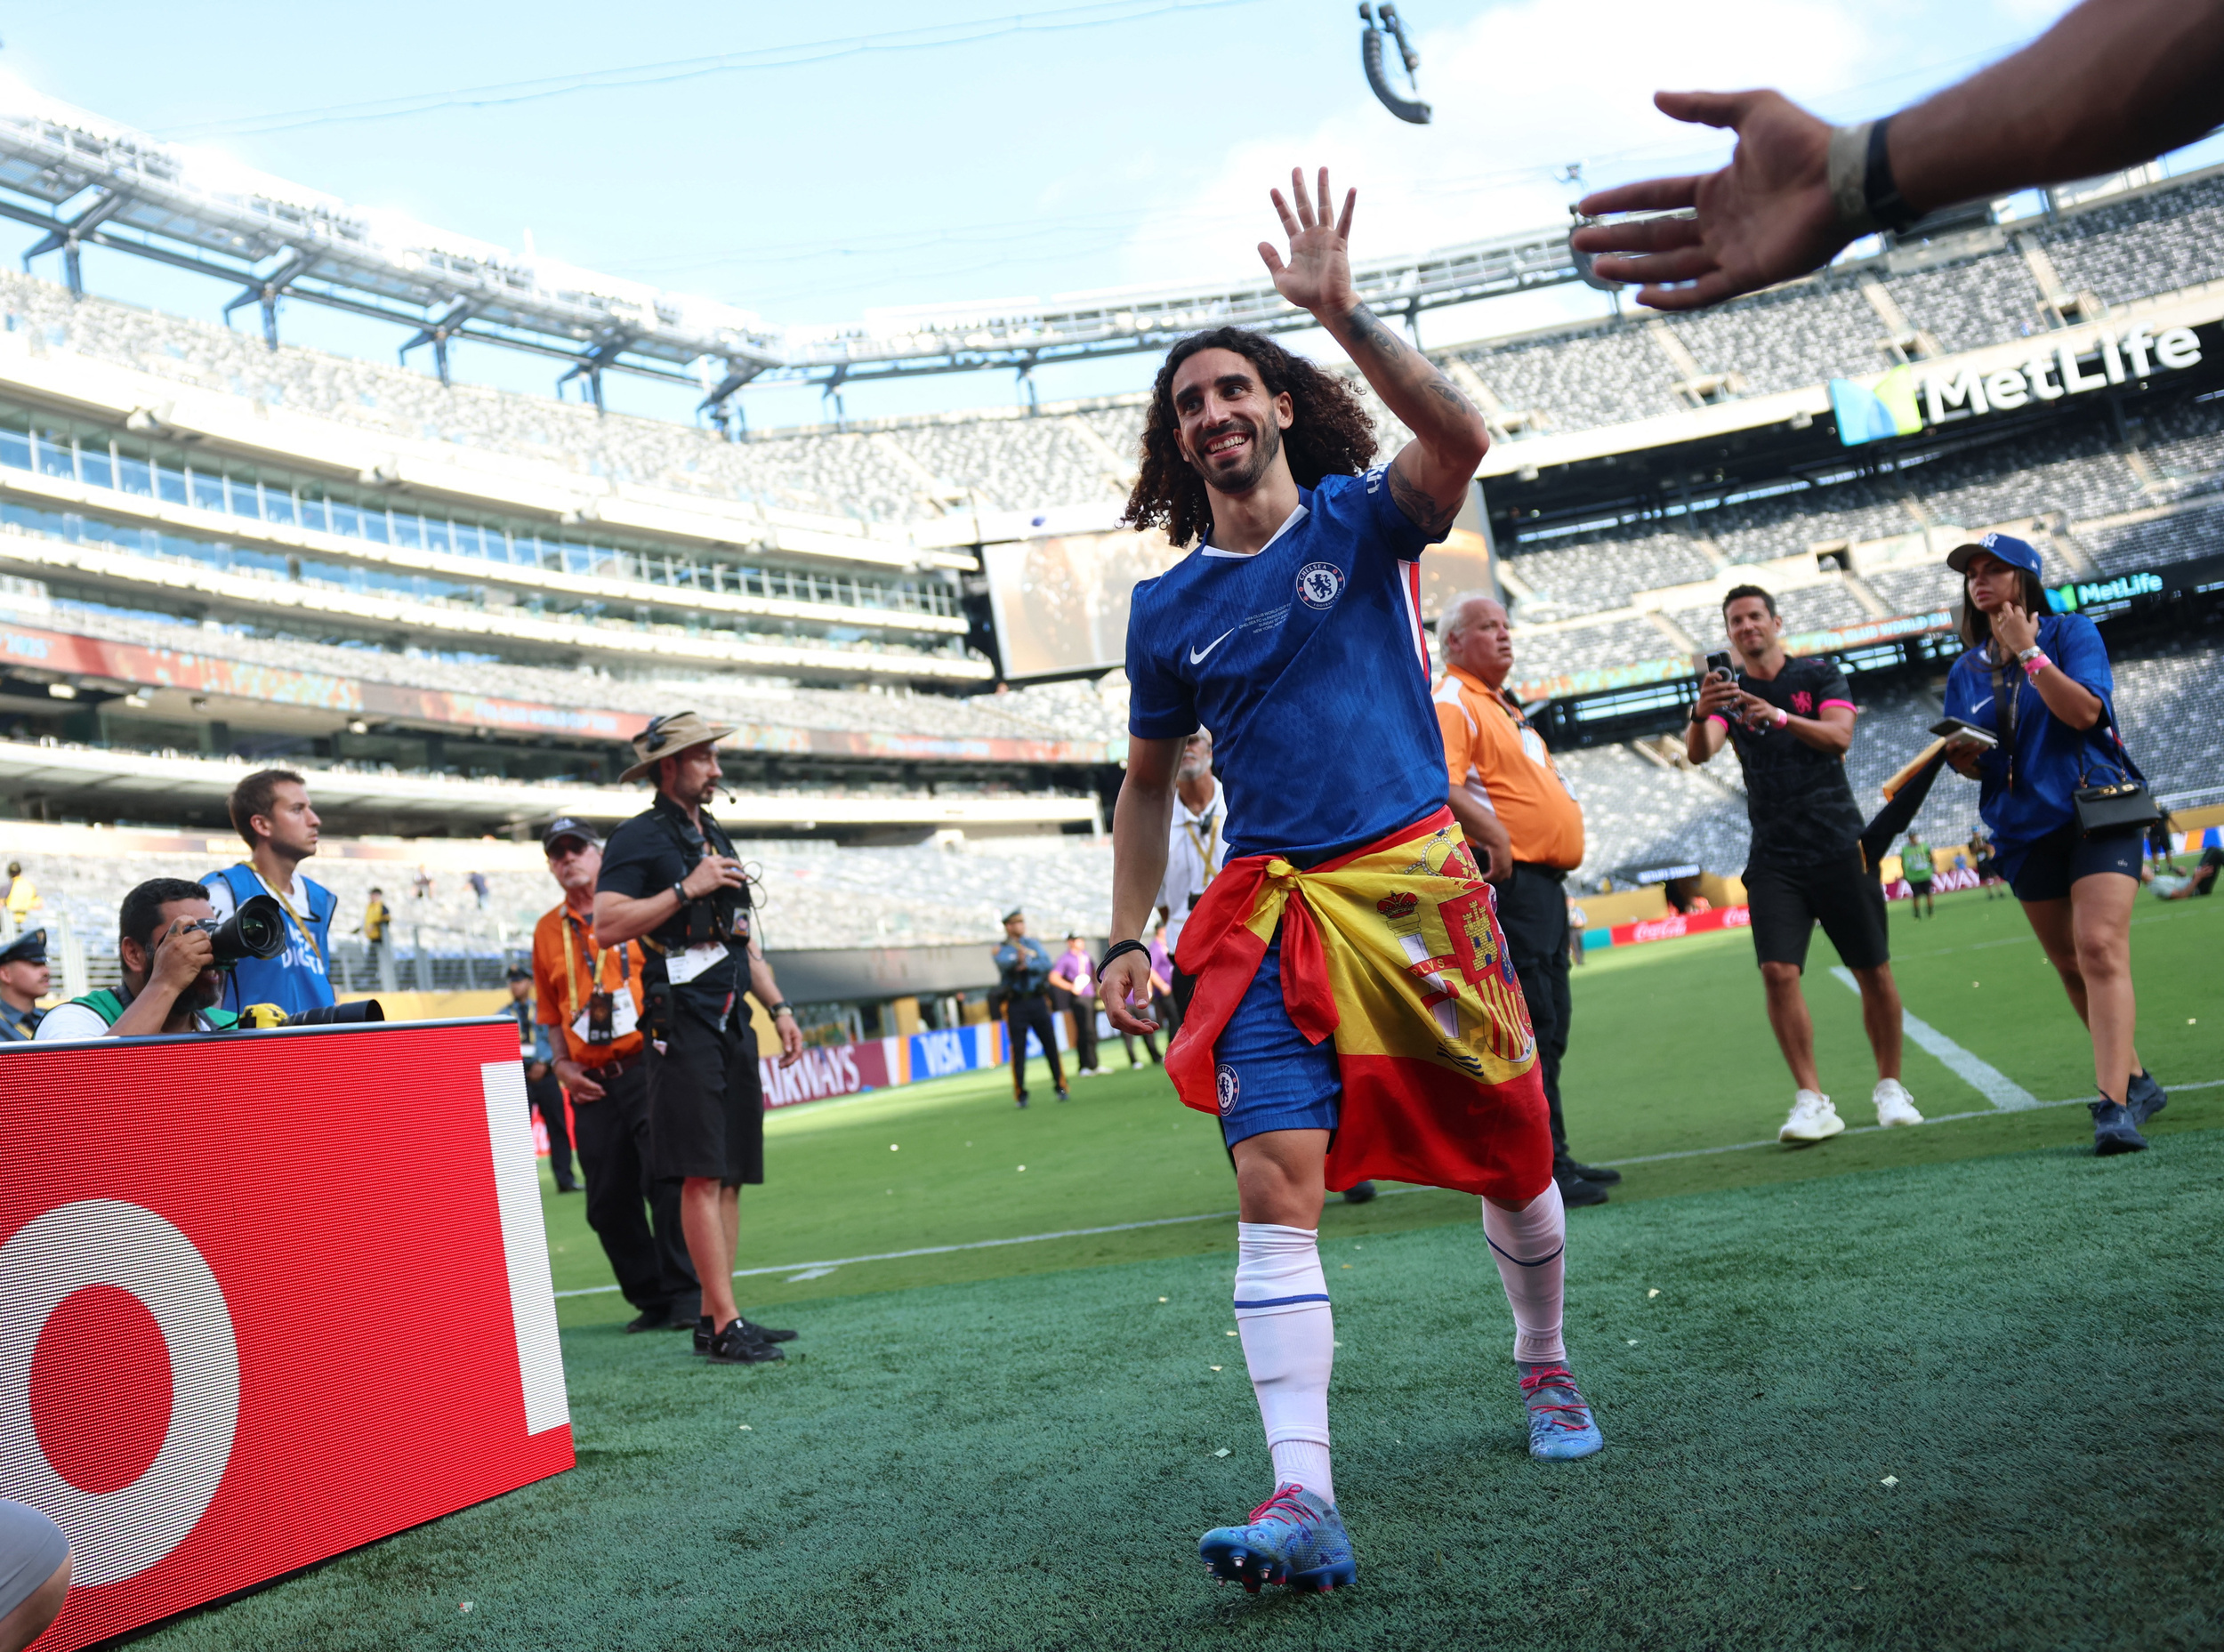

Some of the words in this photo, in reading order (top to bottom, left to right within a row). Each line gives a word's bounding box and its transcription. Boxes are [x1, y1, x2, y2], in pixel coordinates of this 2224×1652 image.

[1923, 321, 2203, 424] MetLife
[1300, 564, 1326, 580] CHELSEA
[2077, 572, 2164, 605] MetLife
[1239, 621, 1256, 629] CHELSEA
[1843, 625, 1878, 642] CLUB
[1879, 616, 1928, 635] WORLD
[1410, 959, 1445, 976] PLVS
[918, 1030, 966, 1077] VISA
[759, 1044, 860, 1106] AIRWAYS
